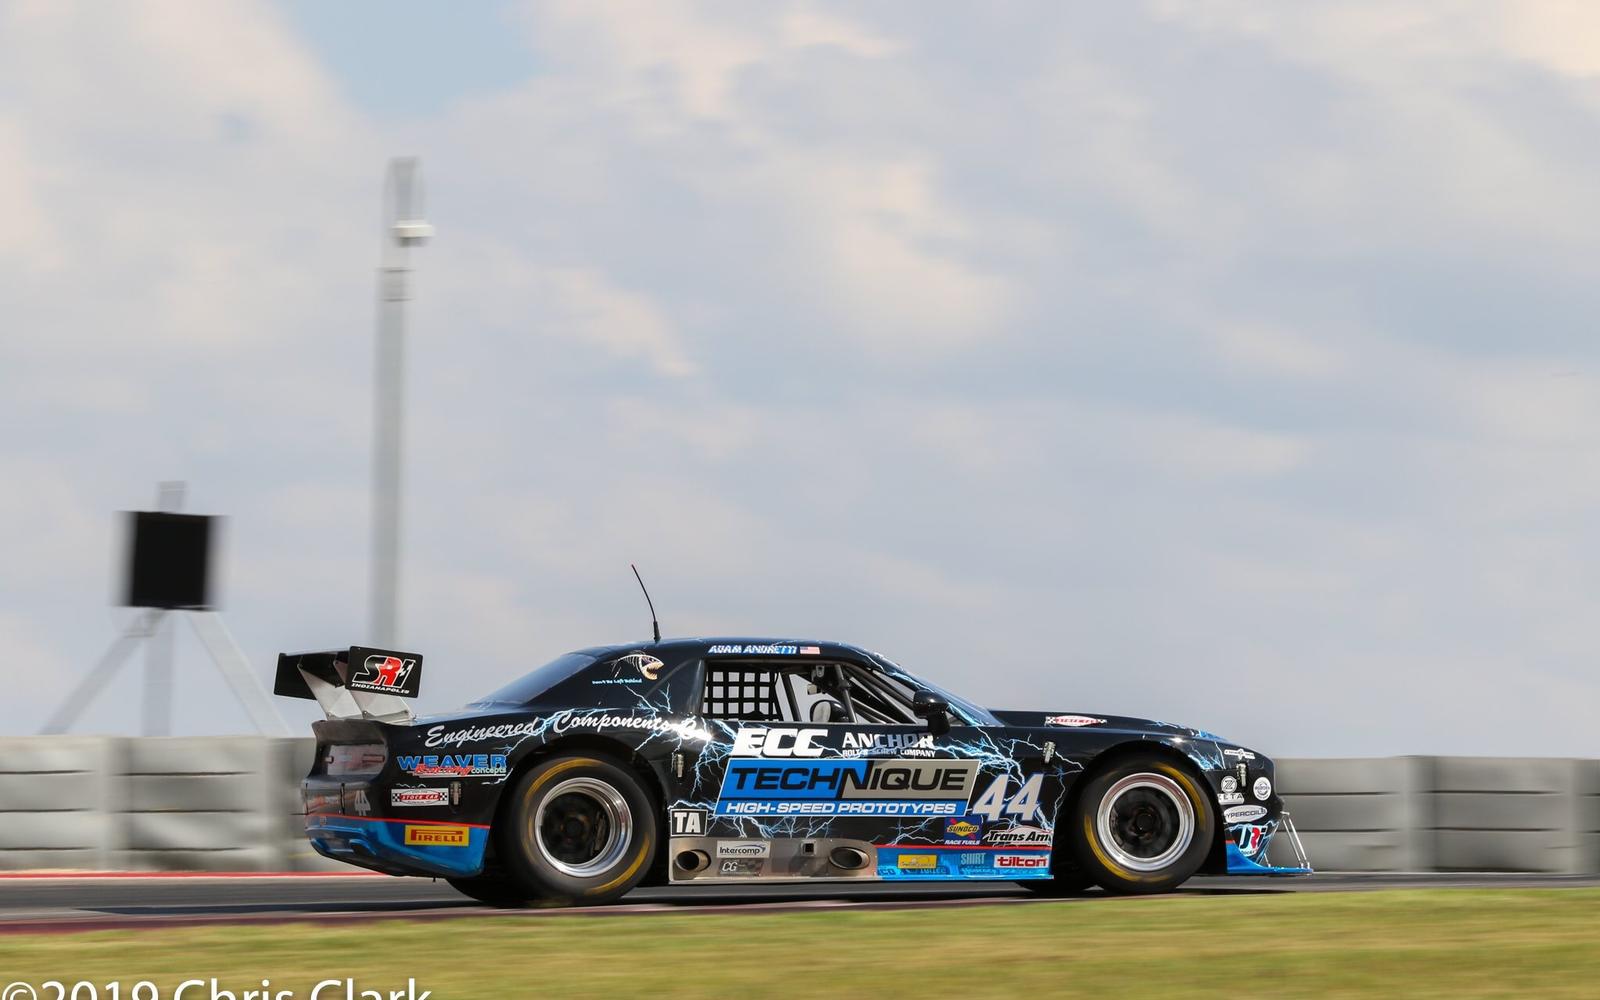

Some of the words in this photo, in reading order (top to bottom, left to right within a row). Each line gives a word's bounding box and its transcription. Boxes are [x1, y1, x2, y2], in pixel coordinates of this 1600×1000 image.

[708, 645, 742, 654] ADAM
[351, 683, 410, 694] INDIANAPOLIS
[425, 717, 540, 748] Engineered
[553, 710, 670, 734] Components
[730, 728, 828, 757] ECC
[842, 732, 935, 749] ANCHOR
[901, 749, 936, 757] COMPANY
[397, 754, 507, 770] WEAVER
[471, 767, 507, 775] concepts
[731, 767, 969, 792] TECHNIQUE
[972, 773, 1044, 821] 44
[726, 803, 835, 814] HIGH-SPEED
[838, 802, 956, 814] PROTOTYPES
[1225, 807, 1266, 818] YPERCOILS
[674, 812, 701, 833] TA
[947, 825, 980, 833] SUNOCO
[411, 829, 464, 842] PIRELLI
[988, 831, 1024, 842] Trans
[1025, 832, 1048, 842] Am
[719, 846, 760, 855] Intercomp
[961, 853, 986, 865] SHIRT
[997, 856, 1048, 867] tilton
[722, 861, 738, 872] CG
